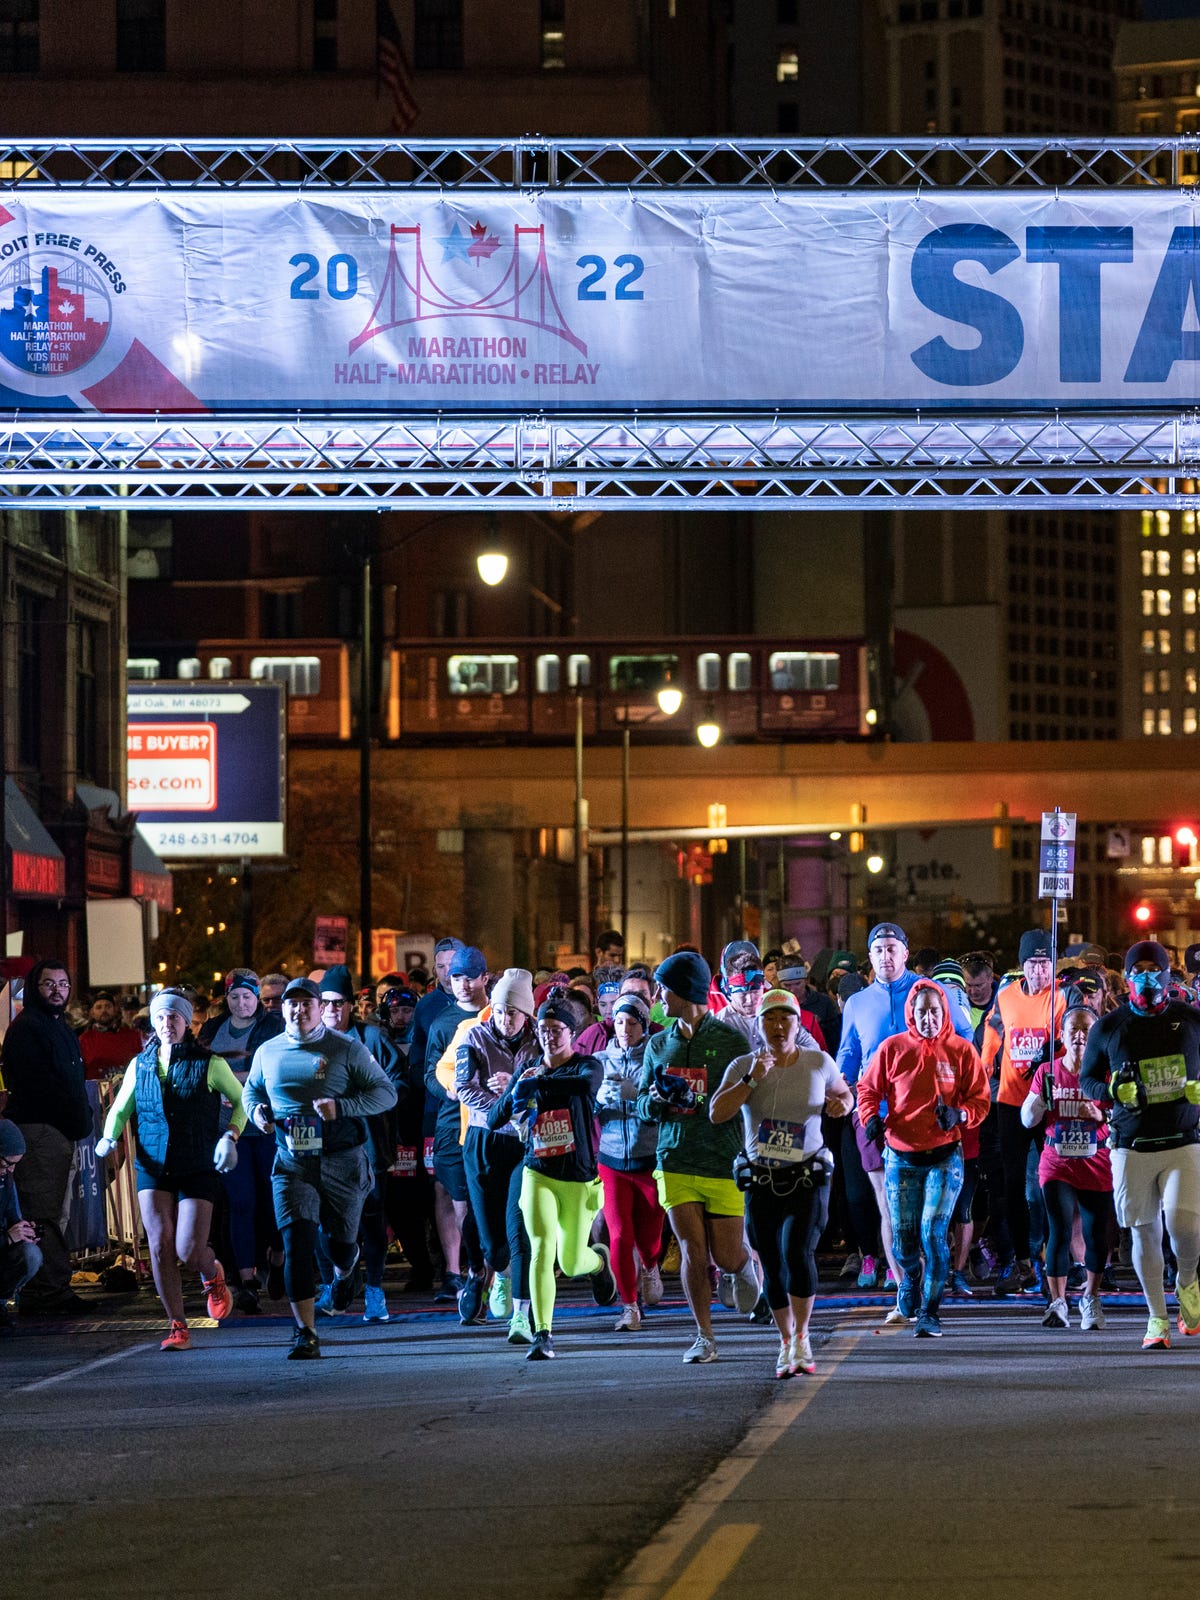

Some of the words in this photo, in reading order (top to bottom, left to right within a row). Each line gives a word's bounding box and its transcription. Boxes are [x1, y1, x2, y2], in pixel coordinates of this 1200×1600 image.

[35, 232, 82, 251] FREE
[83, 244, 127, 294] PRESS
[288, 253, 358, 300] 20
[575, 254, 645, 301] 22
[24, 321, 73, 331] MARATHON
[10, 332, 86, 341] HALF-MARATHON
[25, 342, 53, 351] RELAY
[59, 342, 71, 351] 5K
[408, 337, 527, 358] MARATHON
[27, 353, 48, 361] KIDS
[50, 353, 69, 361] RUN
[33, 363, 64, 372] 1-MILE
[335, 363, 517, 385] HALF-MARATHON
[534, 363, 601, 385] RELAY
[172, 699, 186, 708] MI
[146, 735, 209, 751] BUYER?
[160, 832, 259, 845] 248-631-4704
[1046, 848, 1068, 858] 4:45
[1046, 860, 1068, 869] PACE
[1012, 1036, 1045, 1050] 12307
[1147, 1065, 1180, 1082] 5162
[534, 1120, 570, 1137] 14085
[768, 1131, 794, 1147] 735
[1061, 1132, 1091, 1144] 1233
